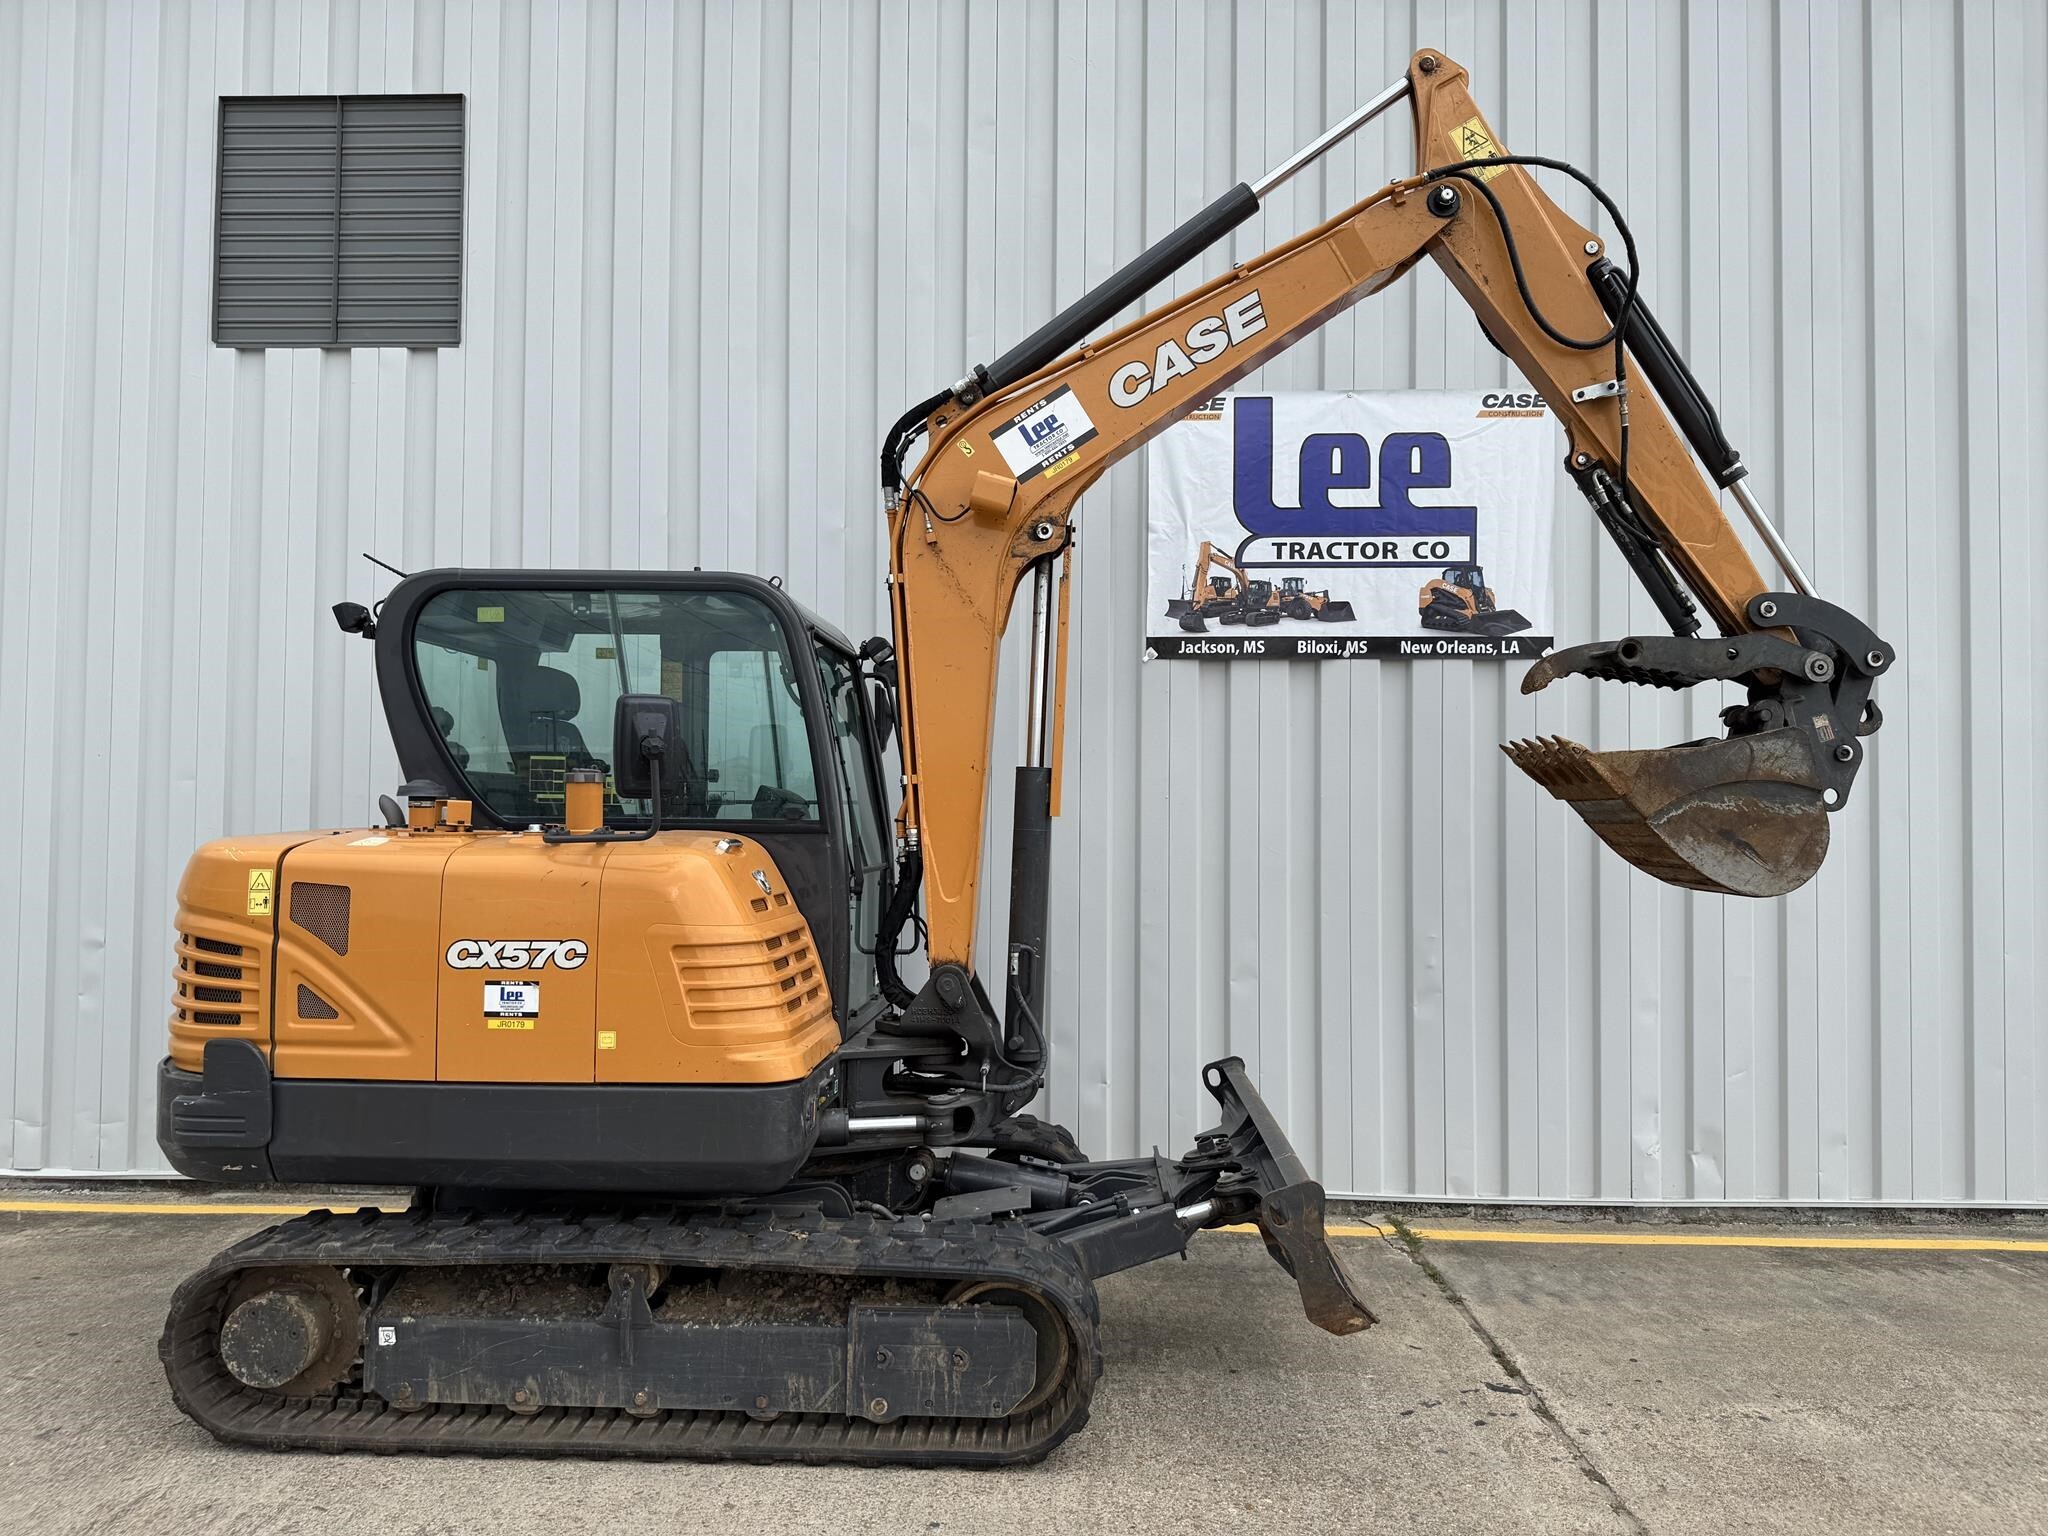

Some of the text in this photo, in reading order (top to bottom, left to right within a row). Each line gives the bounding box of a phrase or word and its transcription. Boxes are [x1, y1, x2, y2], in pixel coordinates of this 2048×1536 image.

[1108, 289, 1268, 409] CASE
[1195, 397, 1227, 411] SE
[1482, 393, 1547, 408] CASE
[1013, 399, 1048, 424] RENTS
[1488, 410, 1543, 418] CONSTRUCTION
[1017, 414, 1065, 447] Lee
[1041, 443, 1075, 468] RENTS
[1052, 456, 1073, 474] JR0179
[1234, 396, 1478, 536] Lee
[1271, 541, 1450, 560] TRACTOR CO
[1178, 640, 1265, 656] Jackson, MS
[1297, 640, 1368, 656] Biloxi, MS
[1400, 640, 1520, 656] New Orleans, LA
[446, 938, 589, 970] CX57C
[500, 986, 525, 1002] Lee
[496, 1020, 526, 1028] JR0179
